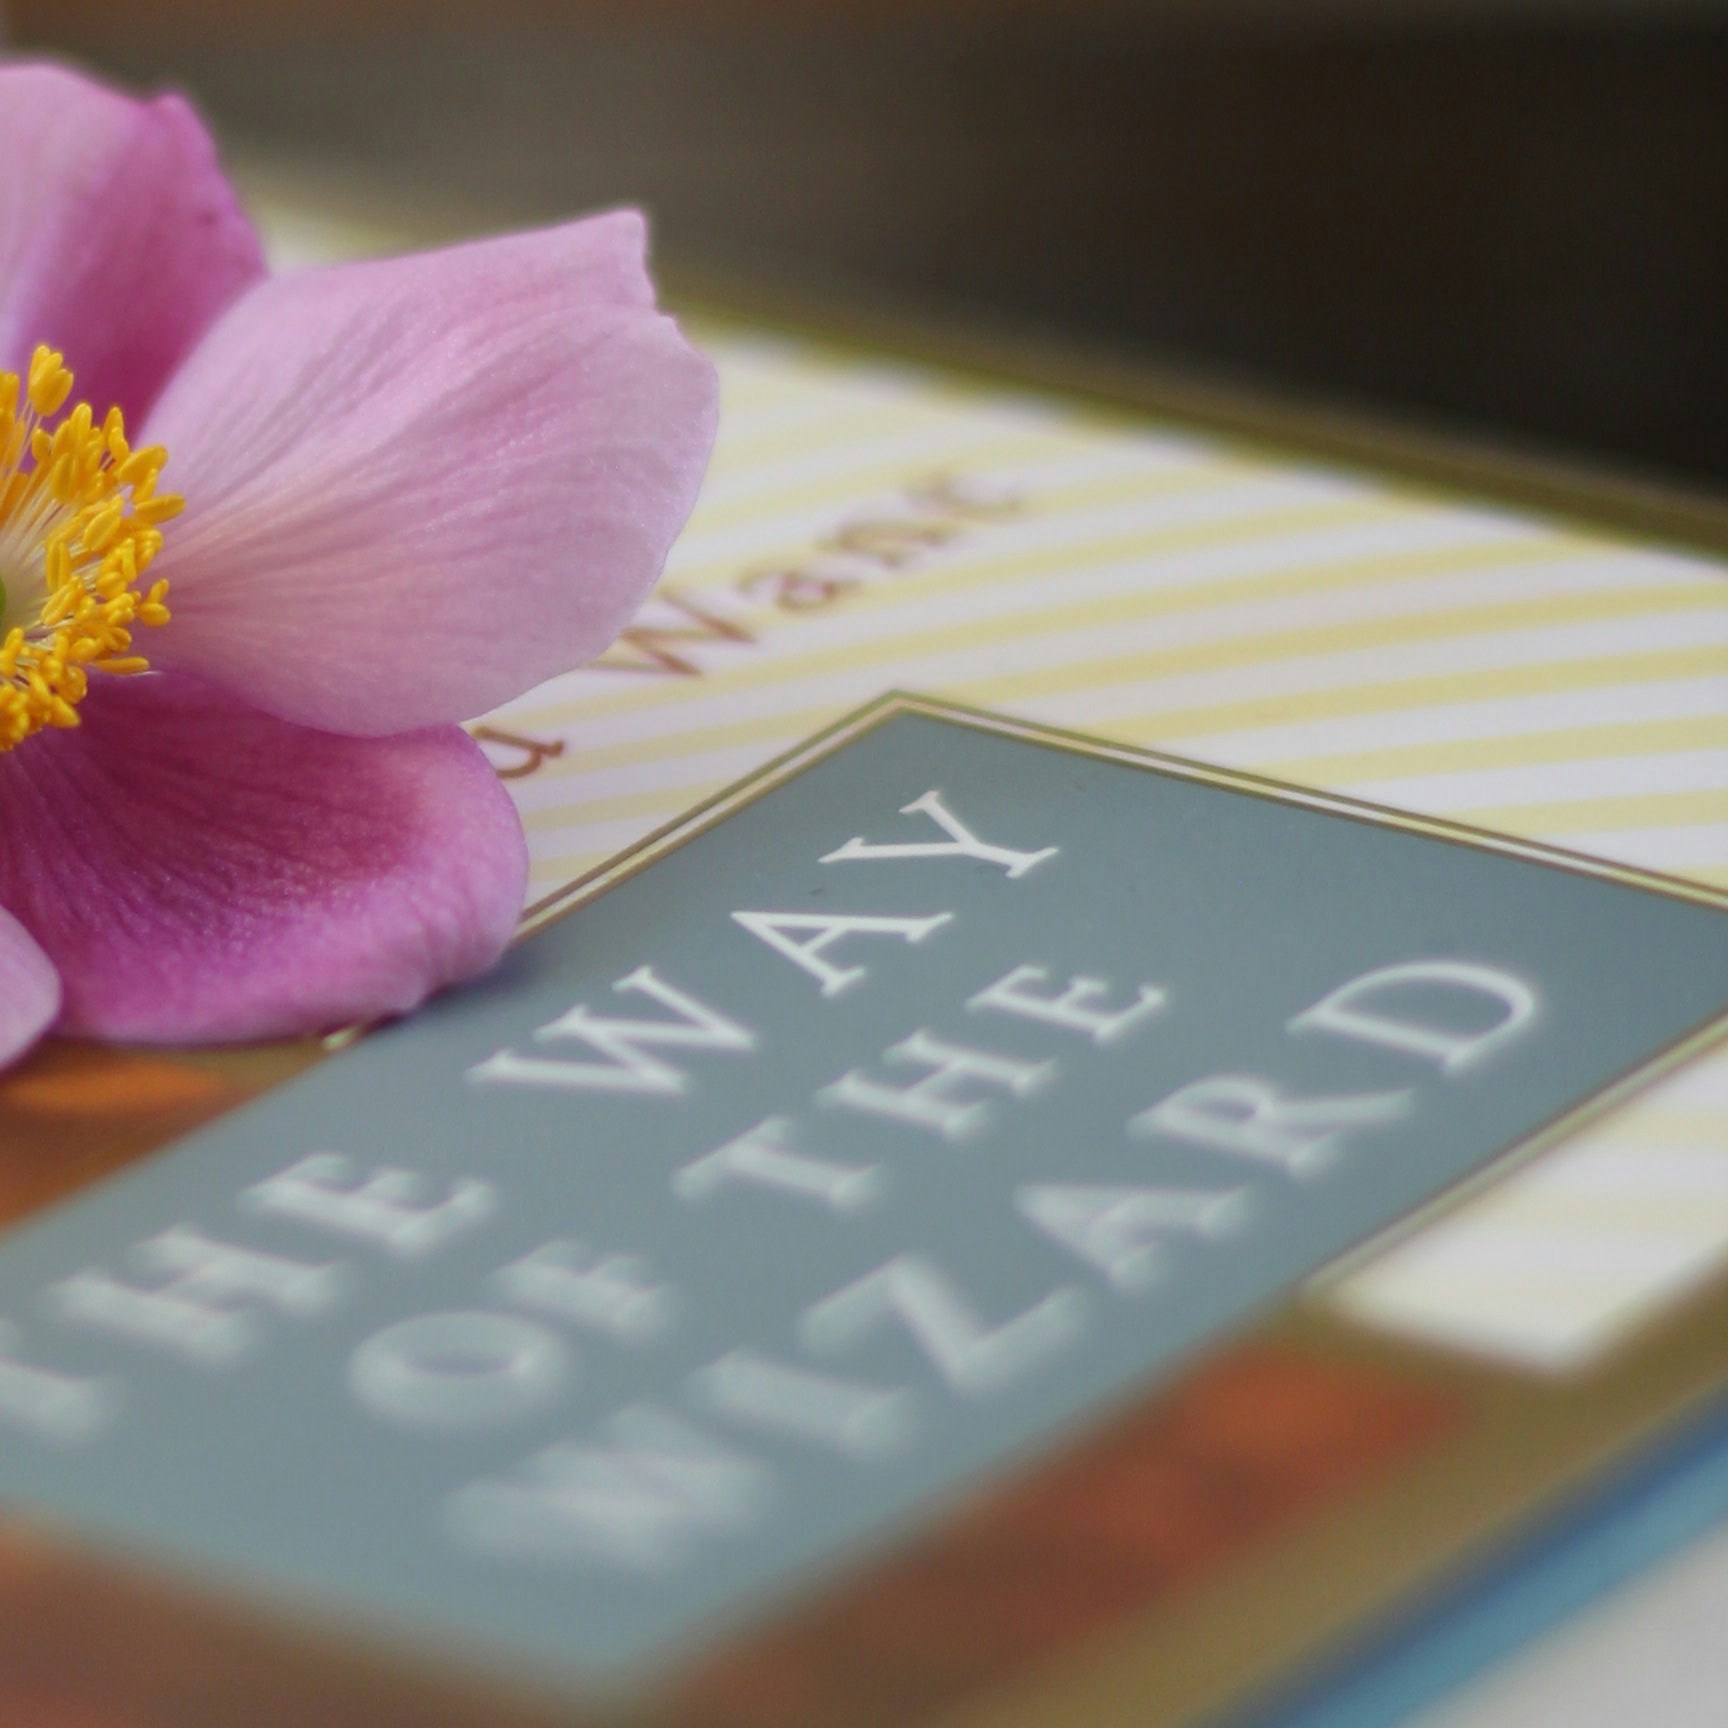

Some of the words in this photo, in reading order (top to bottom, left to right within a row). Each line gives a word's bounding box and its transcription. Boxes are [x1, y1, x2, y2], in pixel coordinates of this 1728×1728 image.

[471, 789, 1060, 1098] WAY
[344, 1239, 672, 1430] OF
[672, 962, 1174, 1210] THE
[446, 956, 1546, 1572] WIZARD
